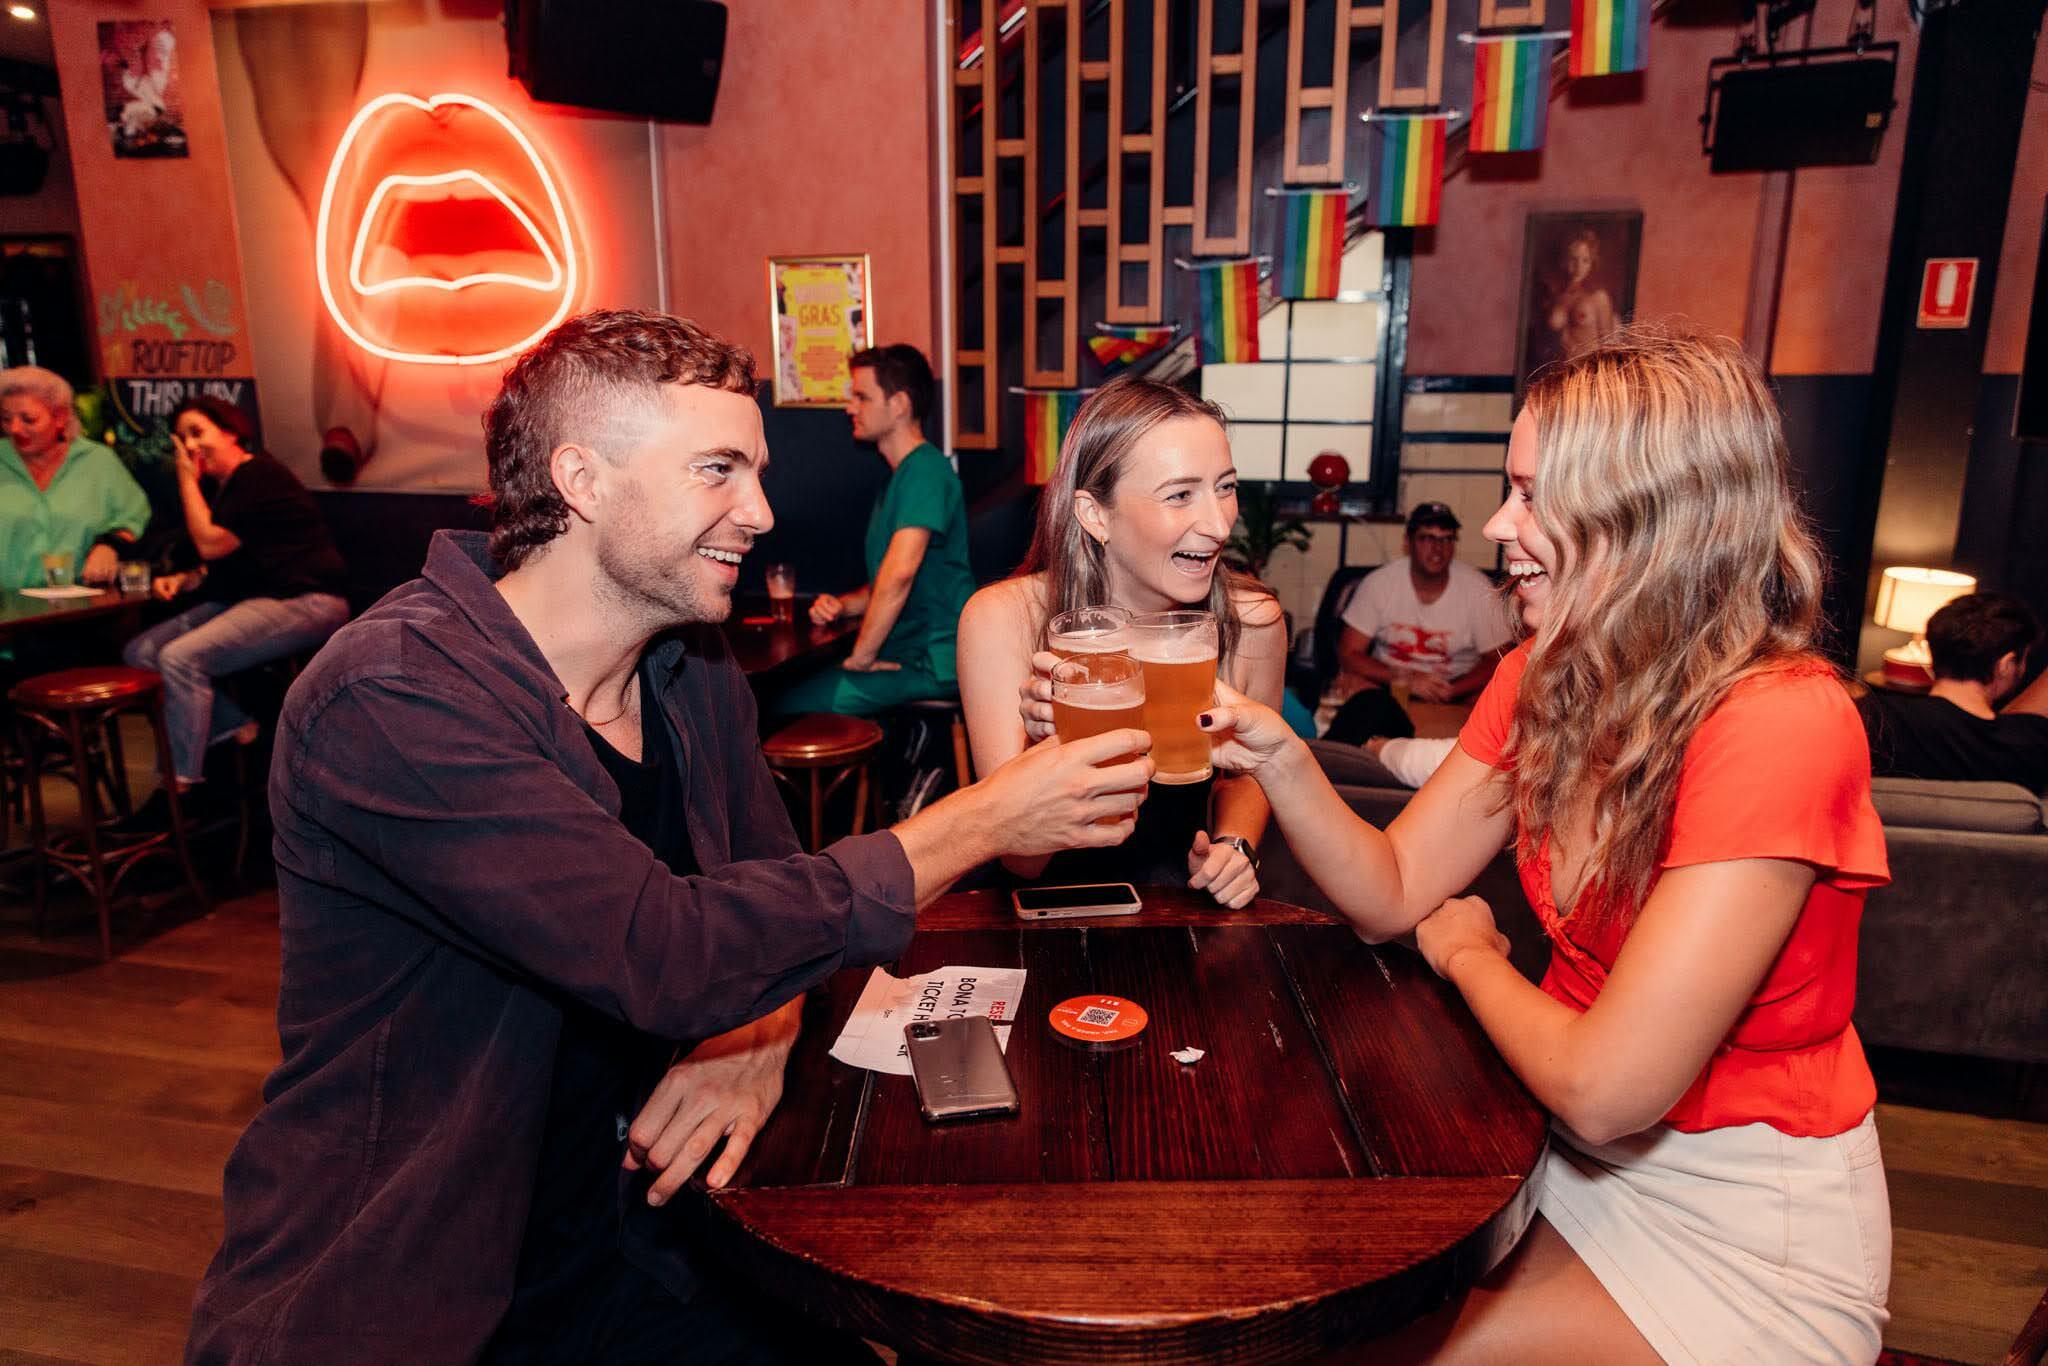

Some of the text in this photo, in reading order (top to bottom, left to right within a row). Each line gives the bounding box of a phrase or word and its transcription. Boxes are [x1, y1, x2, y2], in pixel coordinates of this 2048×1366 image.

[799, 304, 841, 327] GRAS
[132, 338, 237, 375] ROOFTOP
[917, 980, 945, 1014] TICKET
[951, 977, 977, 1006] BONA
